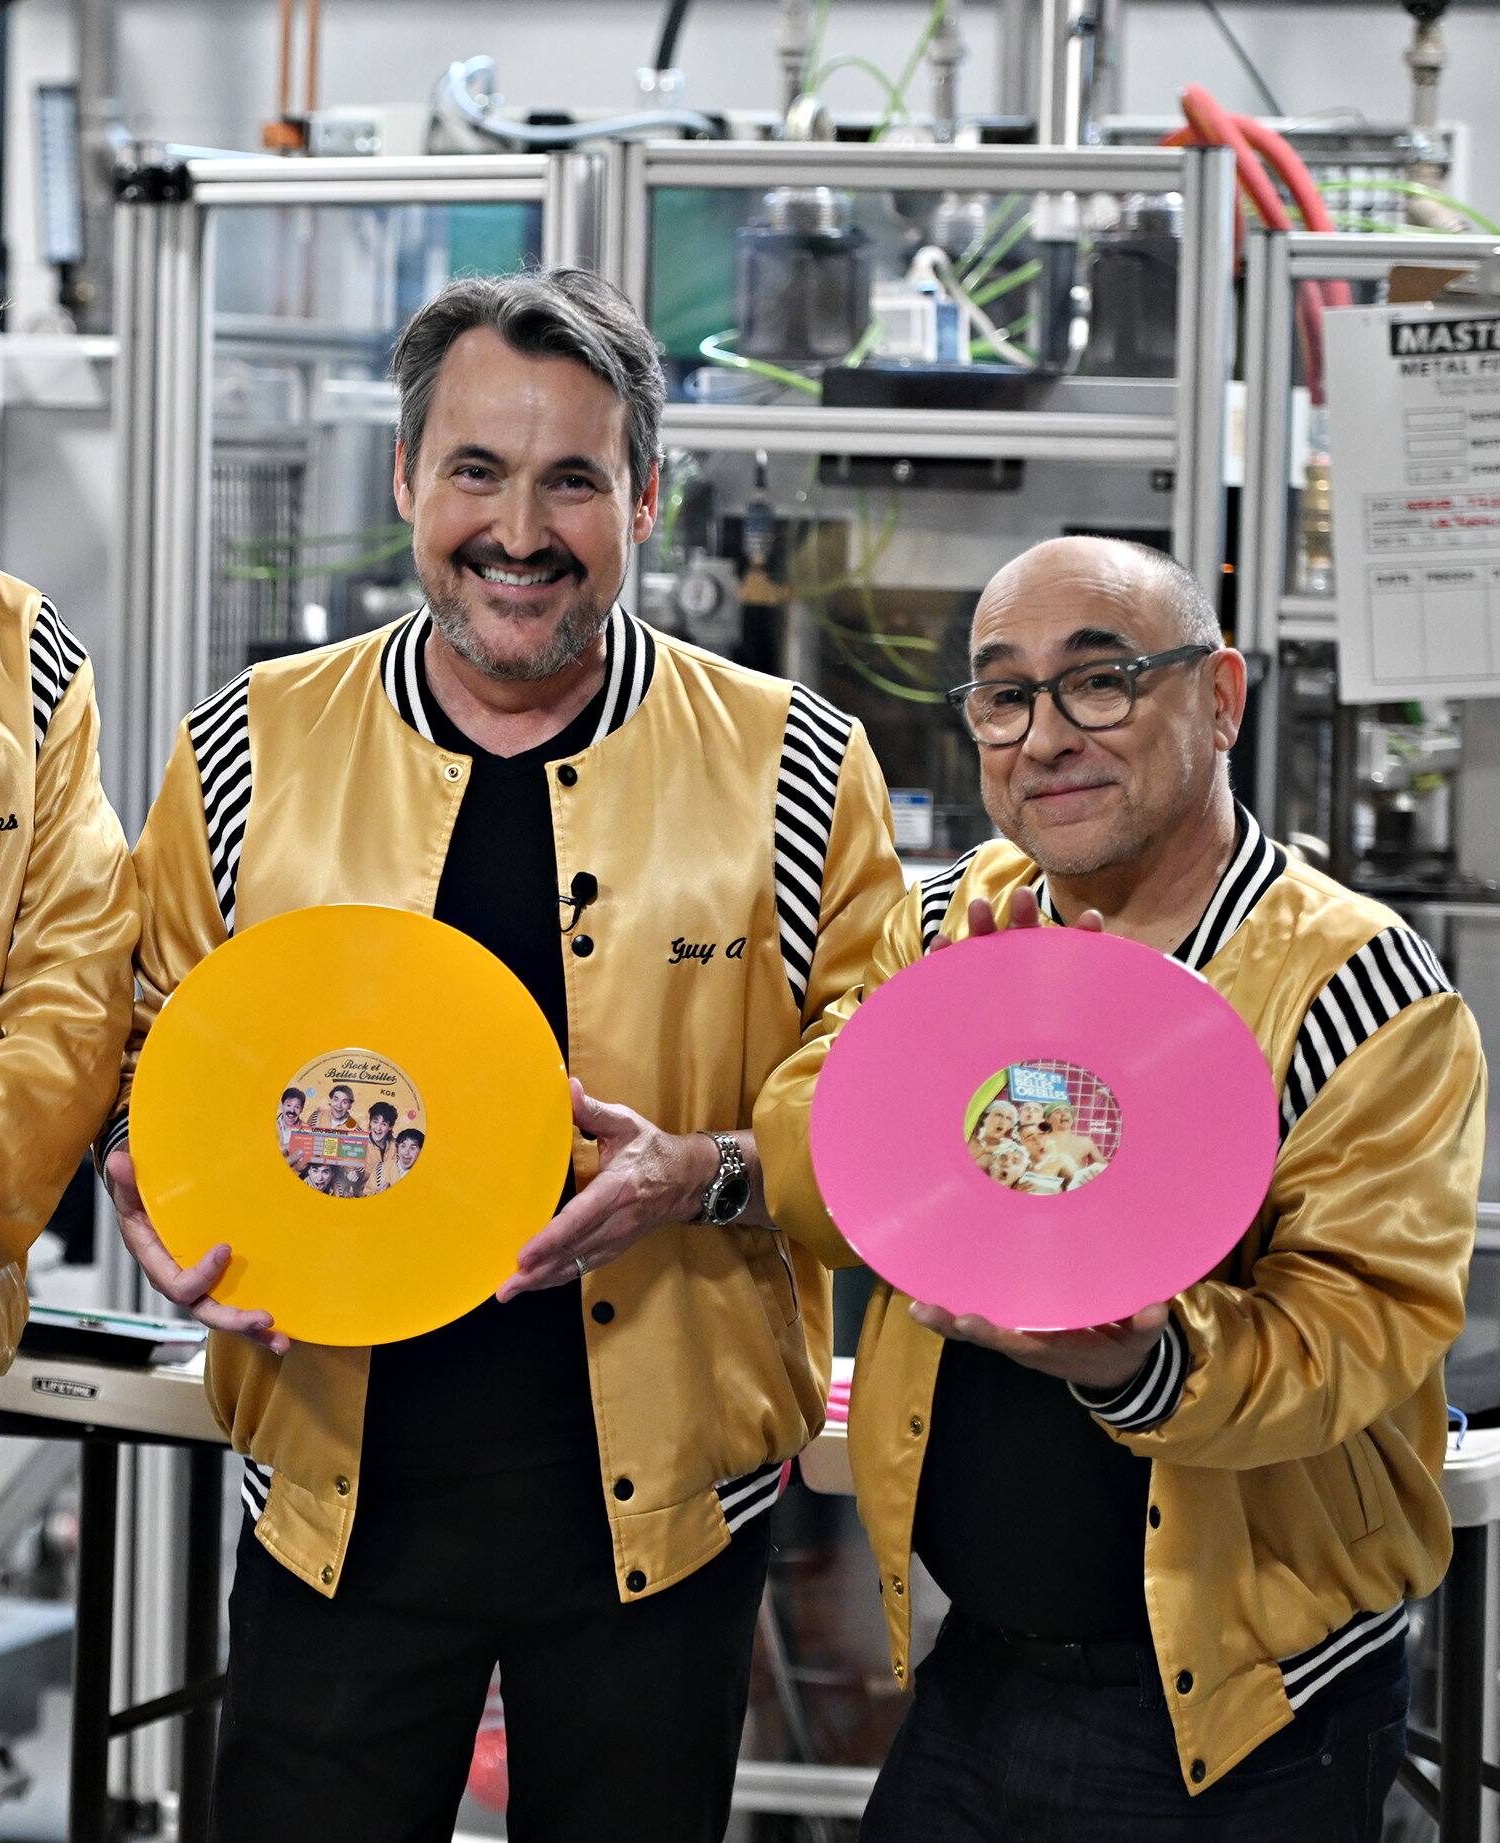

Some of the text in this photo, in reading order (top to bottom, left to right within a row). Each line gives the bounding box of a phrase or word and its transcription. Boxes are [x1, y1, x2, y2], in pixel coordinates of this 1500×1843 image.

[667, 936, 717, 965] Guy
[341, 1059, 381, 1071] Rock et
[324, 1067, 397, 1082] Belles Oreilles
[380, 1088, 396, 1097] KGB
